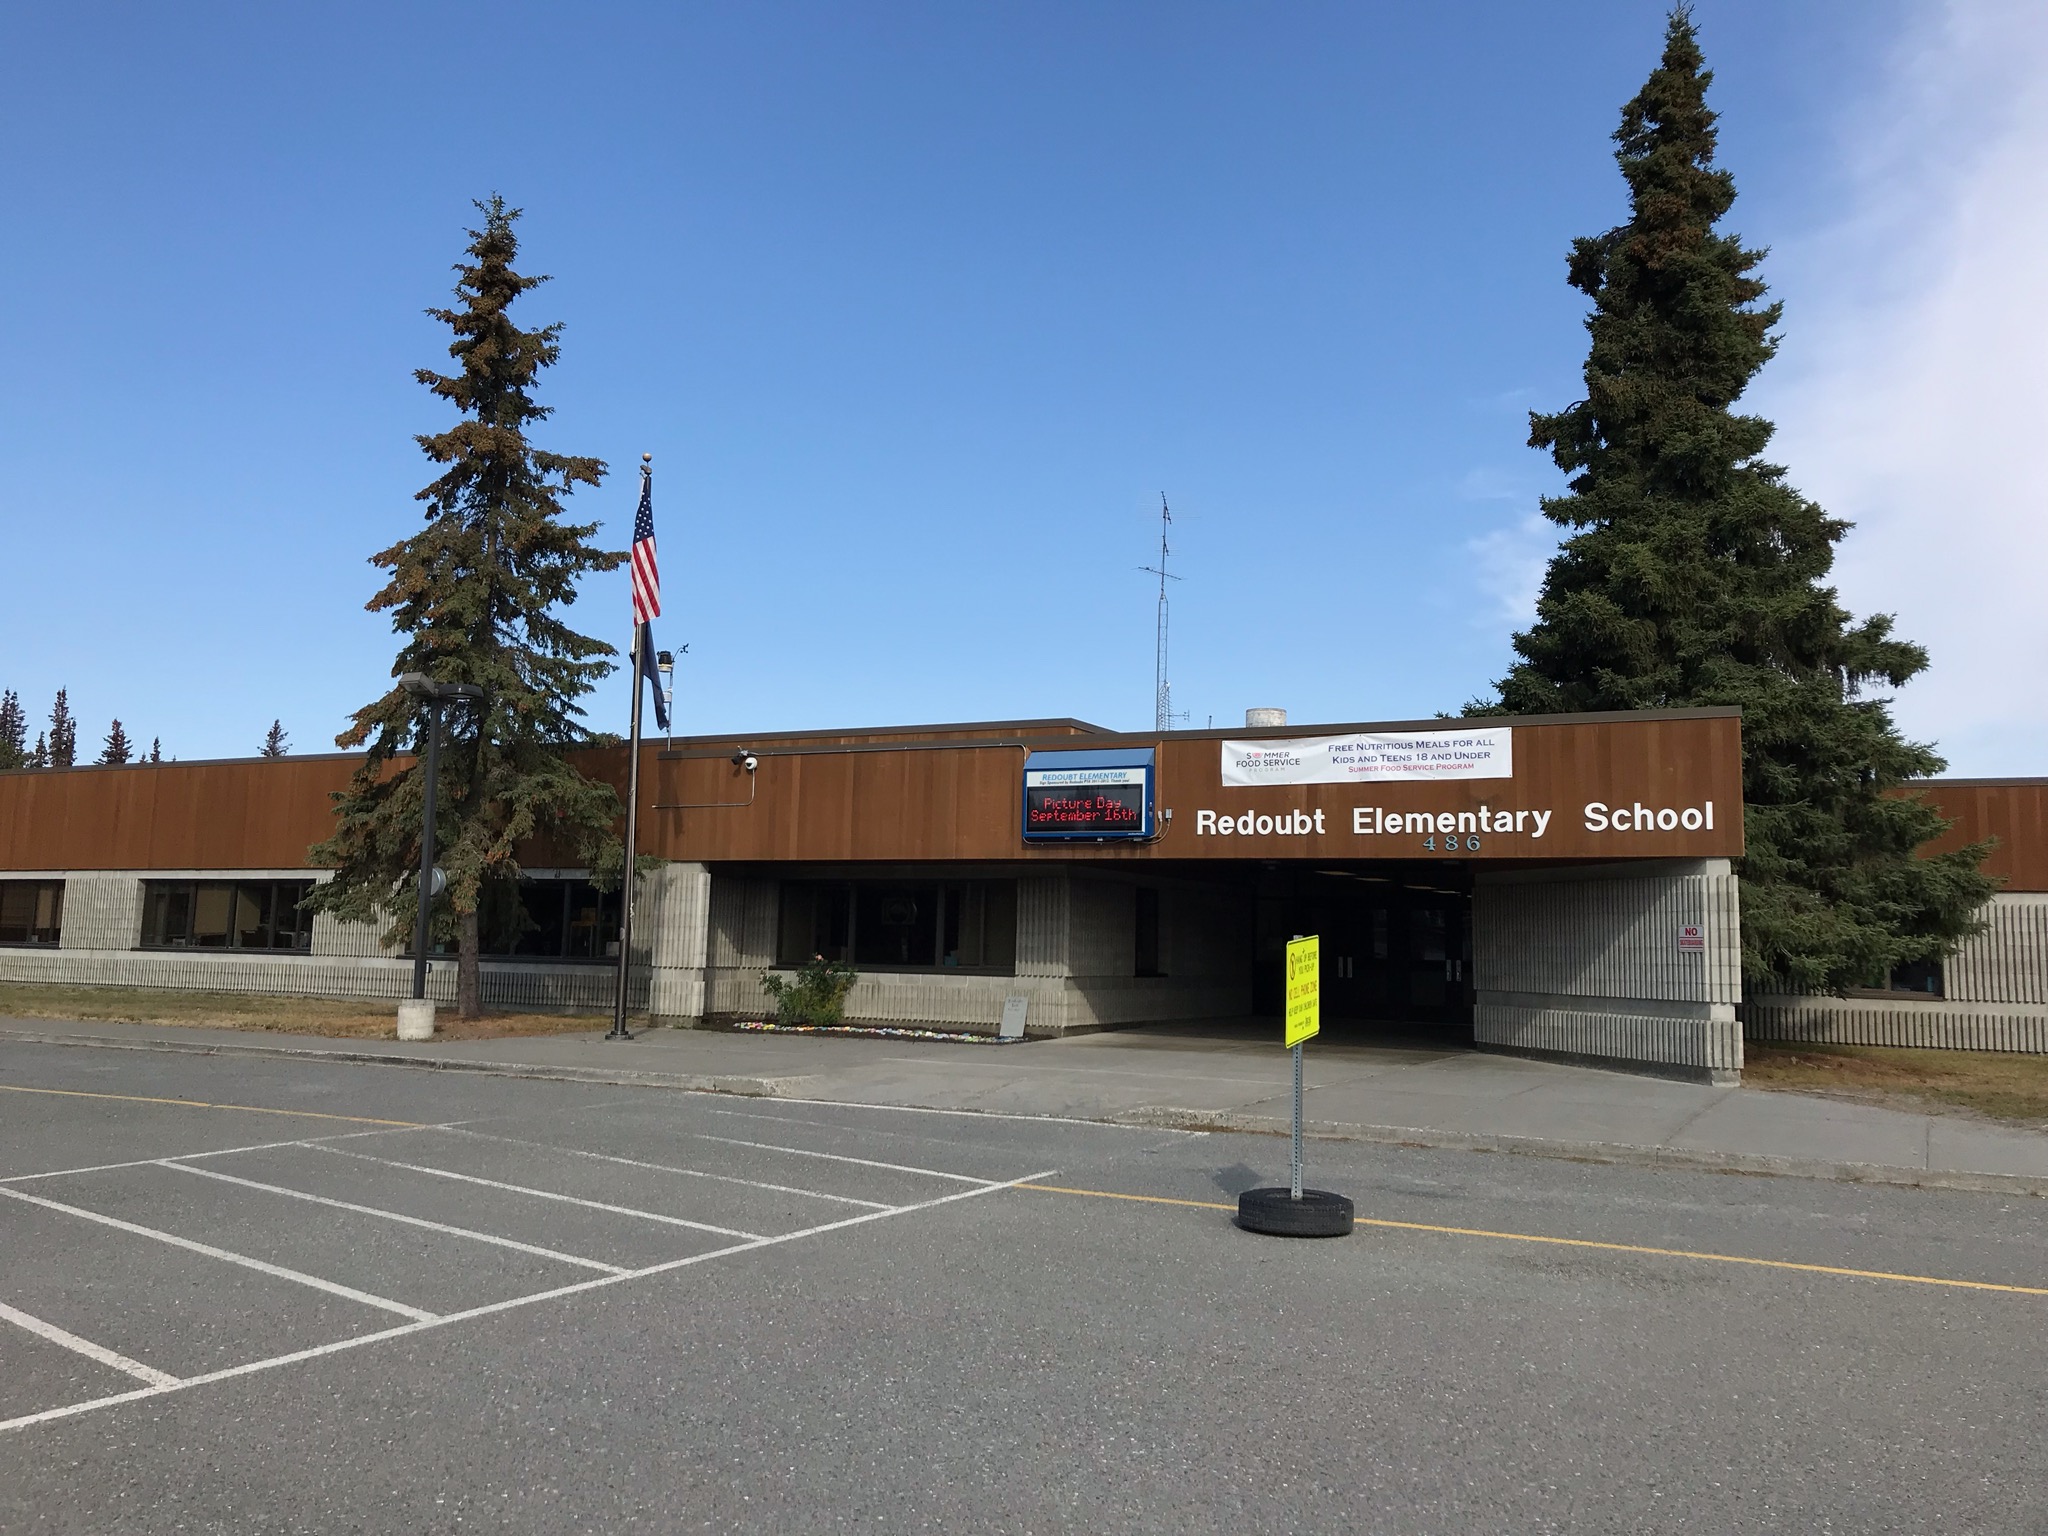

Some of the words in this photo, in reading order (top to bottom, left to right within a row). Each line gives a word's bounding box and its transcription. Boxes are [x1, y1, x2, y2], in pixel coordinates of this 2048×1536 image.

[1328, 744, 1354, 752] FREE
[1356, 742, 1414, 751] NUTRITIOUS
[1415, 740, 1450, 749] MEALS
[1236, 759, 1261, 768] FOOD
[1263, 757, 1301, 767] SERVICE
[1332, 756, 1355, 764] KIDS
[1357, 755, 1378, 763] AND
[1380, 754, 1412, 763] TEENS
[1416, 752, 1428, 761] 18
[1454, 751, 1491, 760] UNDER
[1348, 765, 1379, 773] SUMMER
[1042, 773, 1078, 781] REDOUBT
[1043, 797, 1092, 809] Picture
[1096, 796, 1121, 808] Day
[1031, 809, 1100, 821] September
[1104, 808, 1136, 821] 16th
[1196, 808, 1326, 835] Redoubt
[1353, 805, 1552, 838] Elementary
[1584, 801, 1714, 832] School
[1422, 834, 1481, 851] 486
[1684, 927, 1698, 936] NO
